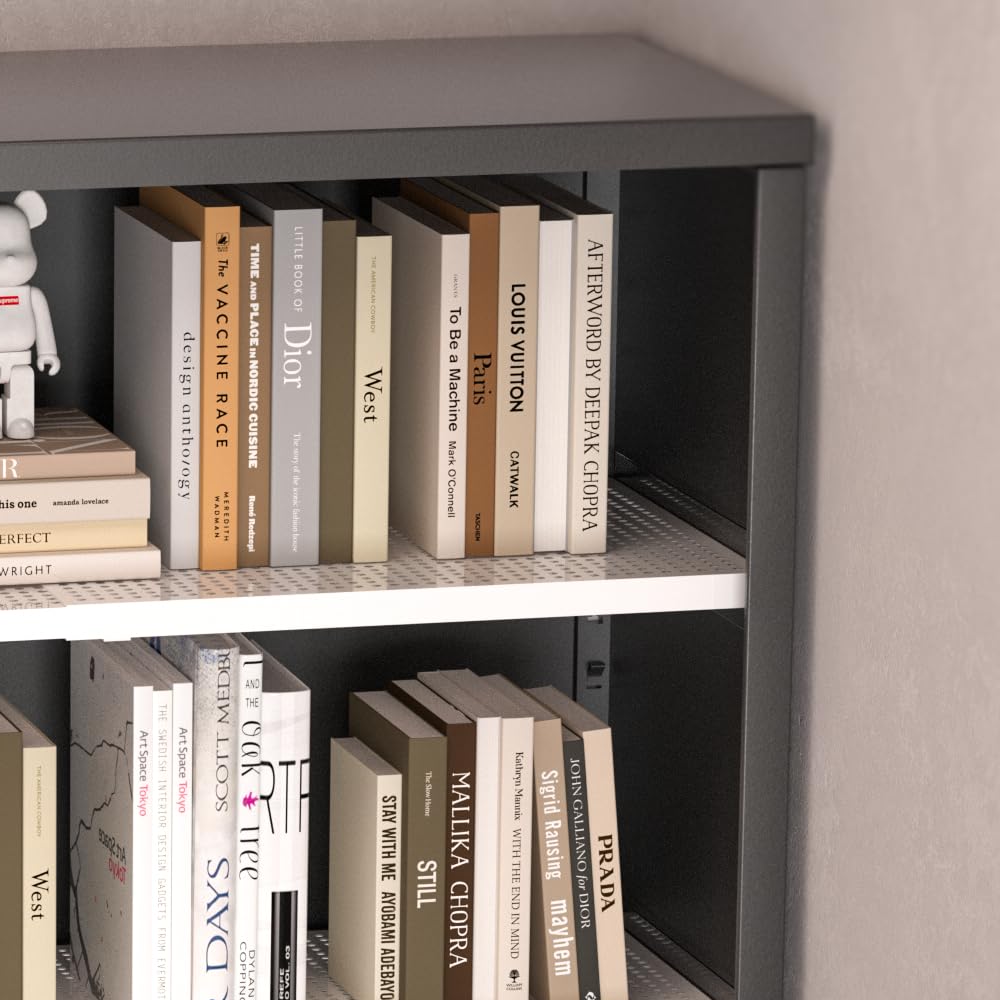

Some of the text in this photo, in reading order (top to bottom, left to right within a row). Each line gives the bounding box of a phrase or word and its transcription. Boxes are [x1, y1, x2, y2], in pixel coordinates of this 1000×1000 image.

[218, 260, 228, 278] The
[216, 285, 228, 380] VACCINE
[283, 322, 312, 389] Dior
[449, 307, 462, 432] To Be a Machine
[510, 284, 526, 412] LOUIS VUITTON
[178, 332, 195, 500] design anthology
[364, 367, 383, 423] West
[473, 353, 492, 405] Paris
[582, 239, 603, 531] AFTERWORD BY DEEPAK CHOPRA
[216, 394, 228, 447] RACE
[18, 500, 37, 508] one
[509, 451, 519, 508] CATWALK
[246, 679, 260, 689] AND
[246, 698, 259, 708] THE
[139, 730, 148, 817] Art Space Tokyo
[178, 727, 188, 813] Art Space Tokyo
[514, 752, 524, 821] Kathryn Mannix
[381, 796, 397, 881] STAY WITH ME
[539, 770, 562, 879] Sigrid Rausing
[570, 758, 591, 929] JOHN GALLIANO for DIOR
[31, 869, 49, 921] West
[417, 860, 437, 909] STILL
[450, 772, 471, 968] MALLIKA CHOPRA
[511, 829, 520, 959] WITH THE END IN MIND
[598, 834, 615, 913] PRADA
[248, 950, 256, 998] DYLAN
[380, 892, 396, 1000] AYOBAMI ADEBAYO
[550, 900, 575, 976] mayhem
